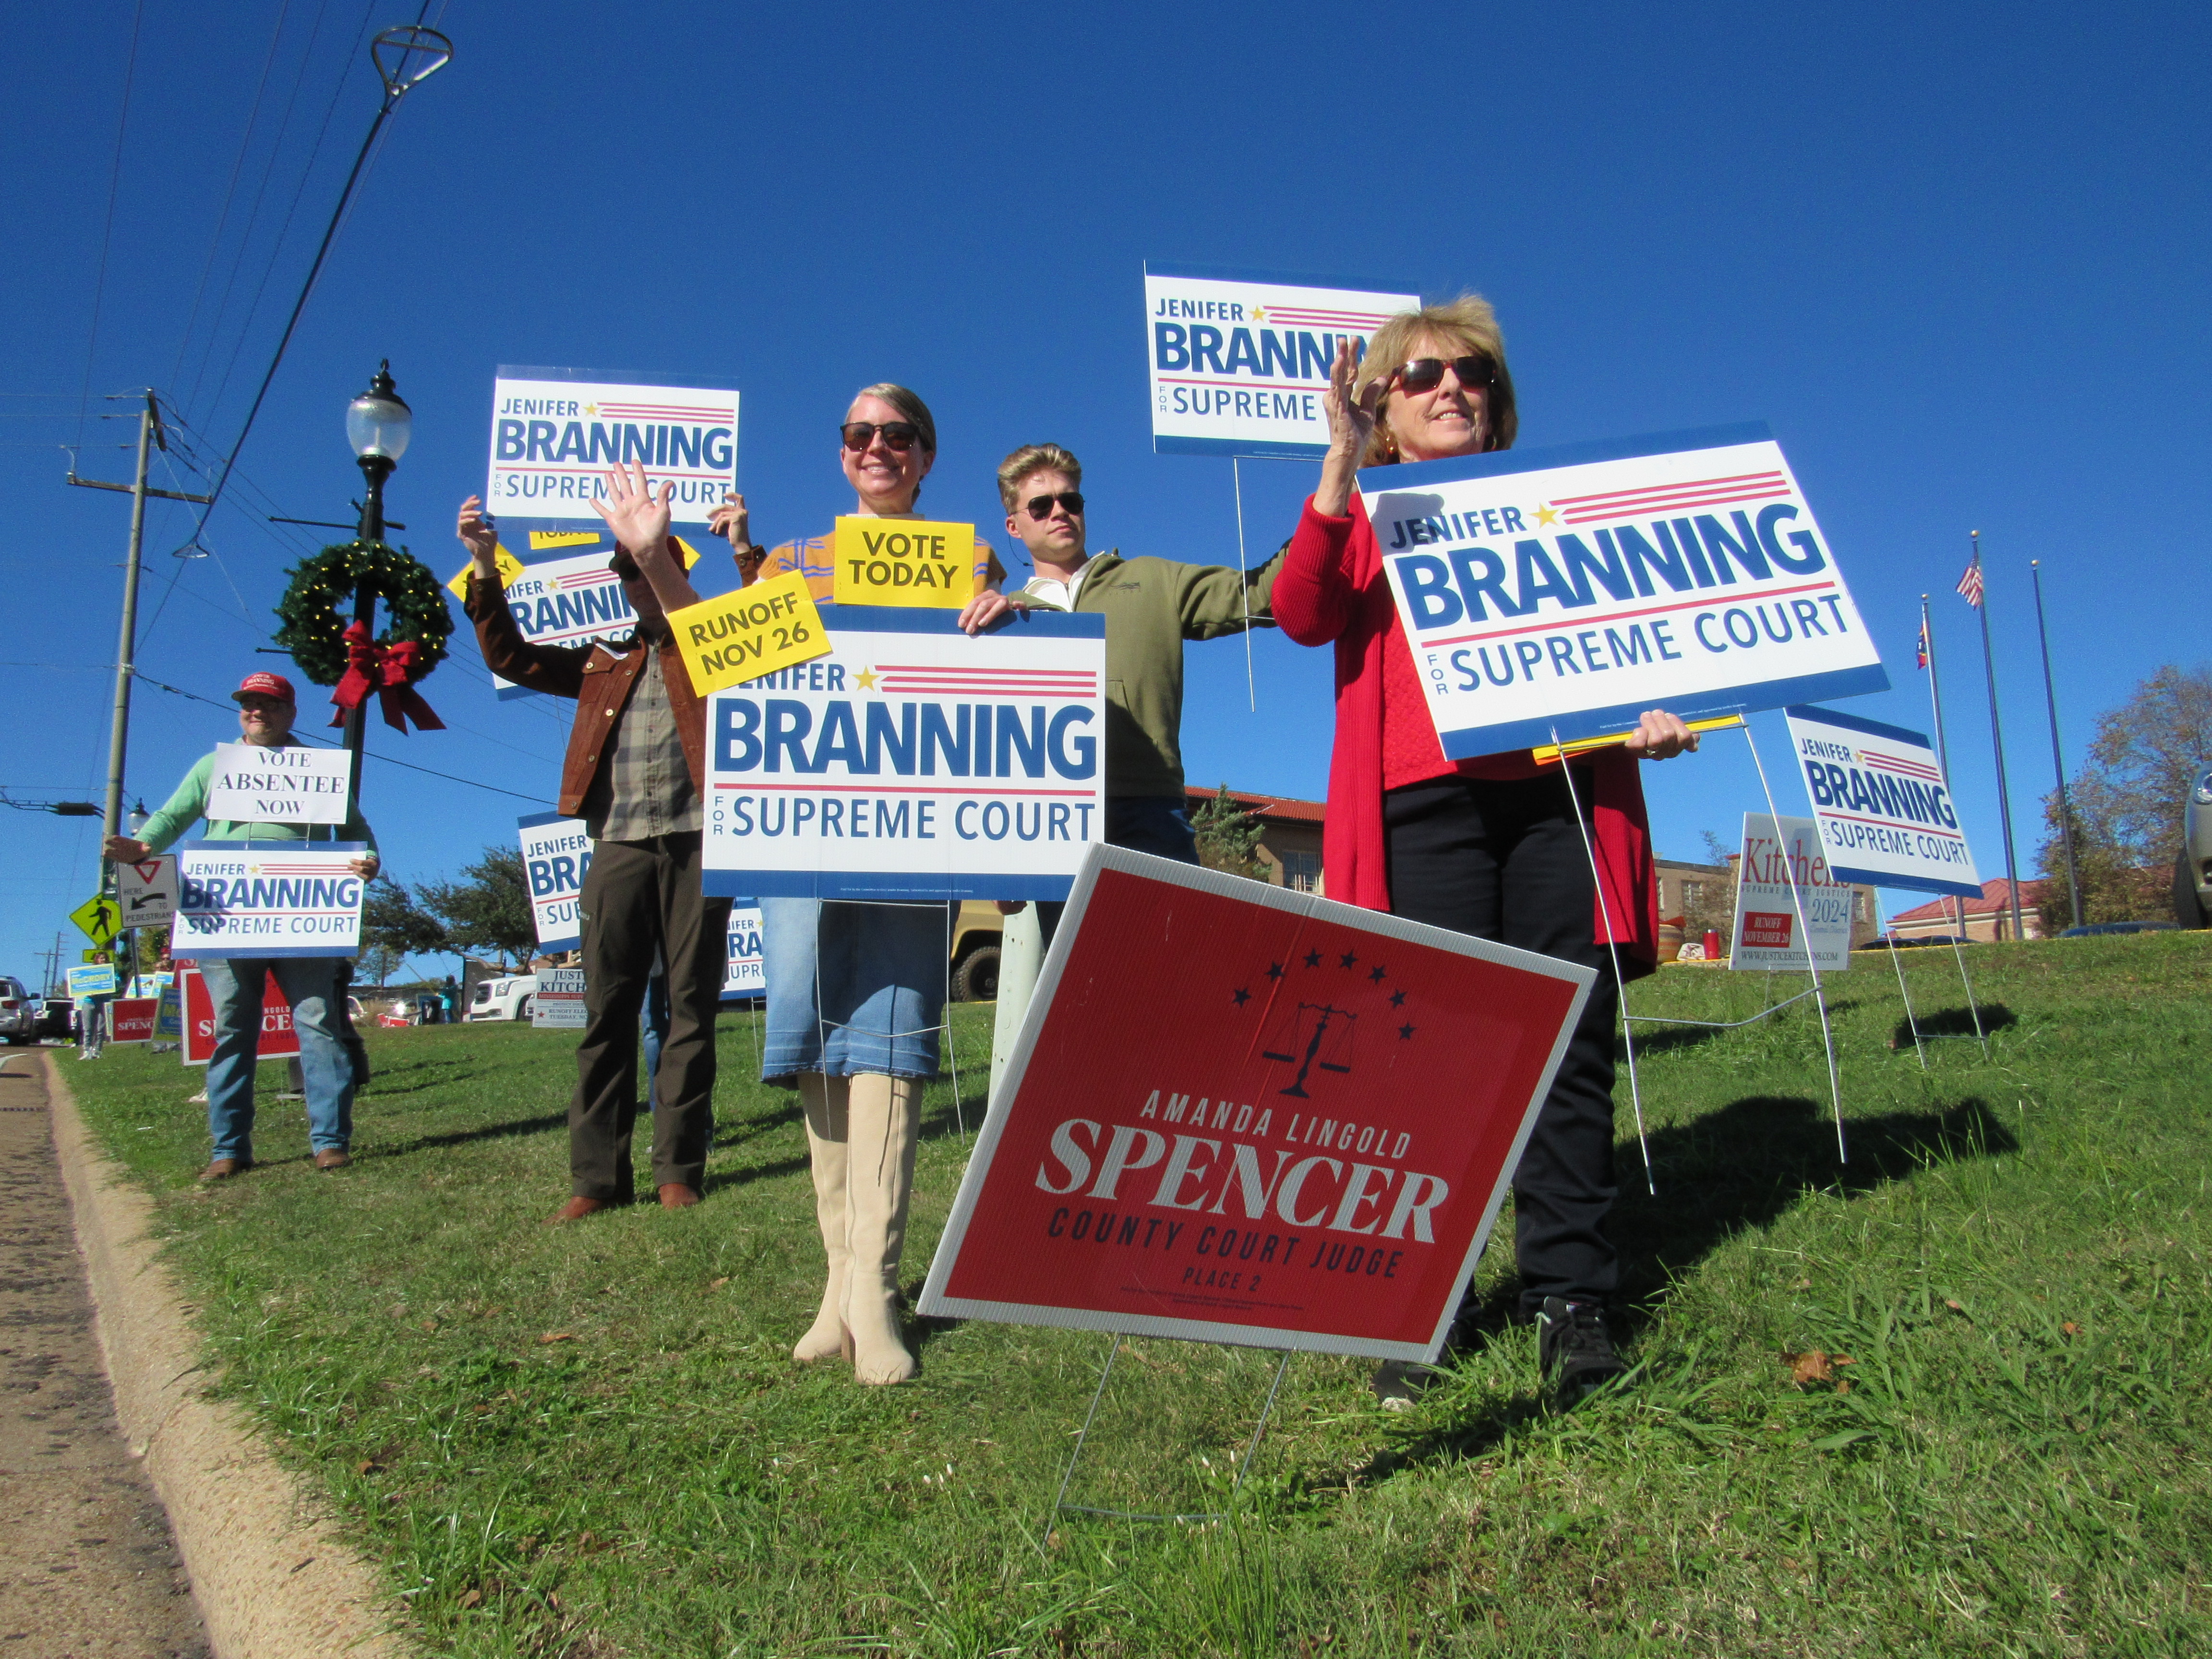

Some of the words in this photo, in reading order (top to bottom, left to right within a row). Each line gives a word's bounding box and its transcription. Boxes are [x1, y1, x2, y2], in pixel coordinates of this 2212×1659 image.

[1155, 298, 1244, 322] JENIFER
[500, 398, 579, 417] JENIFER
[1158, 386, 1167, 412] FOR
[1173, 387, 1317, 421] SUPREME
[496, 419, 733, 470] BRANNING
[493, 474, 502, 497] FOR
[1390, 506, 1527, 549] JENIFER
[862, 531, 946, 560] VOTE
[849, 560, 959, 589] TODAY
[1394, 503, 1826, 631] BRANNING
[689, 592, 798, 647] RUNOFF
[701, 634, 763, 676] NOV
[772, 621, 810, 651] 26
[1450, 619, 1683, 692] SUPREME
[1694, 594, 1848, 653] COURT
[1426, 653, 1449, 695] FOR
[714, 697, 1096, 780] BRANNING
[1801, 738, 1852, 763] JENIFER
[259, 752, 312, 767] VOTE
[216, 773, 345, 793] ABSENTEE
[1804, 759, 1958, 830] BRANNING
[254, 799, 305, 815] NOW
[713, 796, 723, 835] FOR
[732, 795, 936, 839] SUPREME
[955, 800, 1095, 841] COURT
[528, 835, 588, 857] JENIFER
[1831, 821, 1914, 856] SUPREME
[1917, 835, 1969, 865] COURT
[187, 864, 245, 875] JENIFER
[181, 878, 360, 908] BRANNING
[187, 917, 283, 935] SUPREME
[291, 916, 357, 934] COURT
[1754, 917, 1782, 928] RUNOFF
[1811, 899, 1850, 923] 2024
[1743, 931, 1780, 943] NOVEMBER
[1741, 951, 1838, 961] WWW.JUSTICEKITCHNS.COM
[541, 982, 585, 992] KITCH
[1140, 1089, 1272, 1136] AMANDA
[1285, 1114, 1411, 1159] LINGOLD
[1034, 1118, 1449, 1244] SPENCER
[1047, 1207, 1184, 1250] COUNTY
[1197, 1226, 1300, 1266] COURT
[1309, 1241, 1404, 1279] JUDGE
[1182, 1267, 1242, 1290] PLACE
[1249, 1274, 1262, 1292] 2
